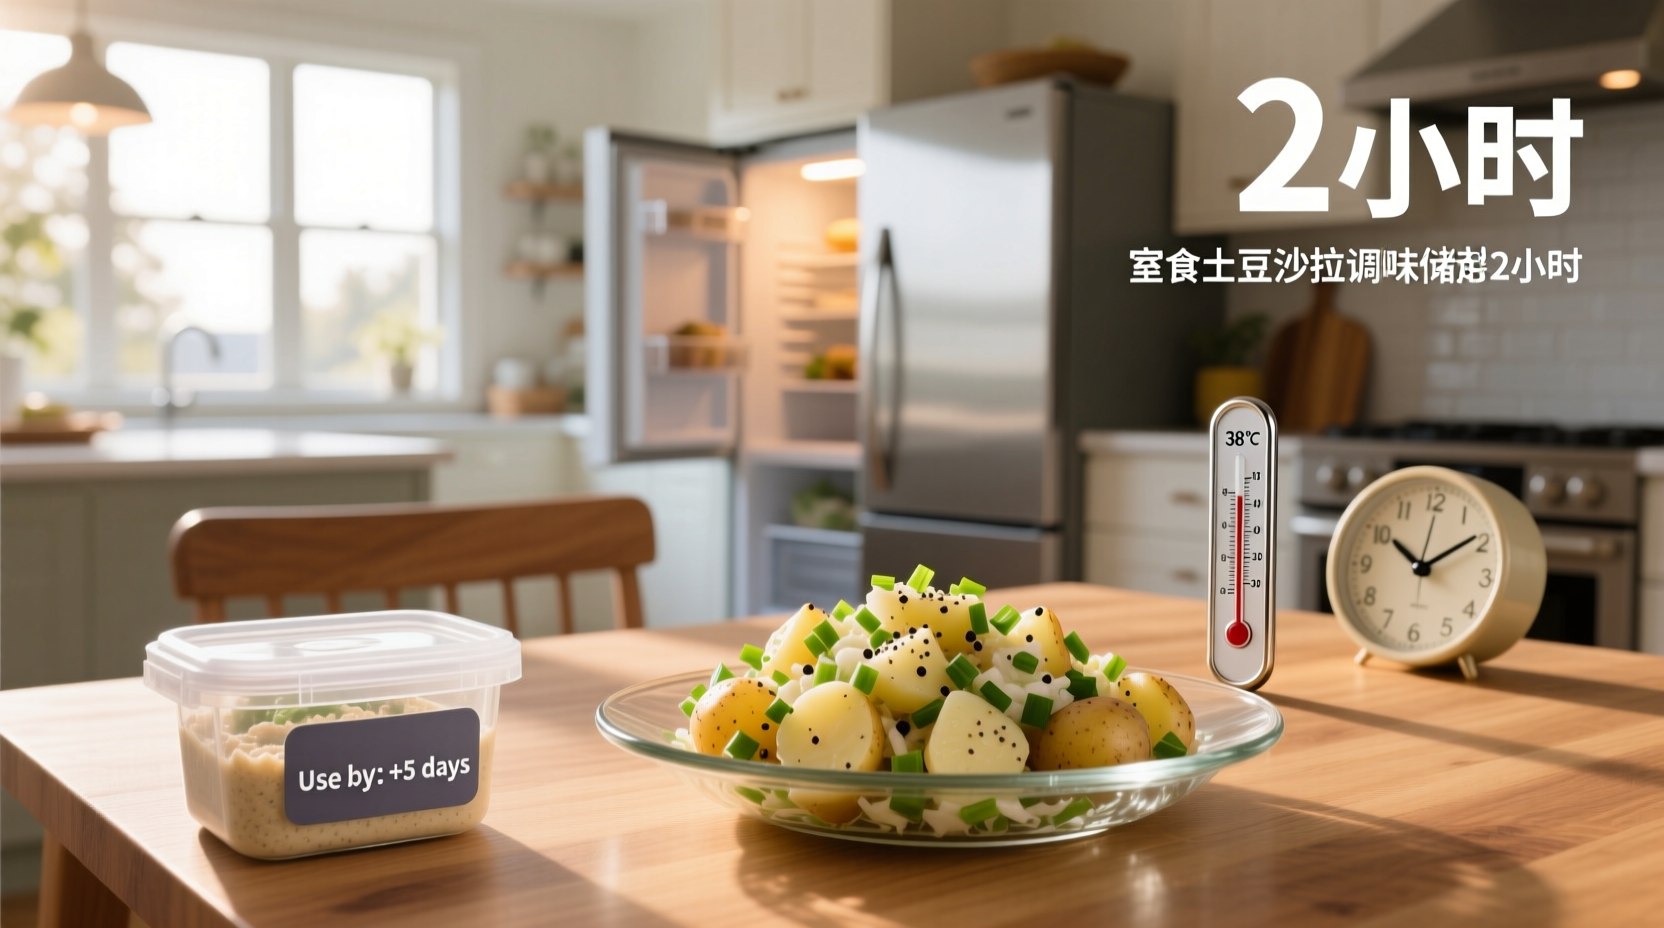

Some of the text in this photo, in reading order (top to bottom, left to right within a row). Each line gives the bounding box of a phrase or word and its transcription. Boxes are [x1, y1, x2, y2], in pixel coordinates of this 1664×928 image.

[1397, 501, 1411, 520] 11
[1426, 493, 1446, 513] 12
[1461, 506, 1467, 525] 1
[1373, 524, 1391, 544] 10
[1475, 533, 1490, 553] 2
[1360, 555, 1372, 574] 9
[1478, 568, 1493, 588] 3
[1363, 586, 1377, 606] 8
[1383, 609, 1394, 629] 7
[1462, 600, 1475, 619] 4
[1407, 622, 1420, 642] 6
[1440, 617, 1453, 637] 5
[299, 755, 471, 793] Use by: +5 days
